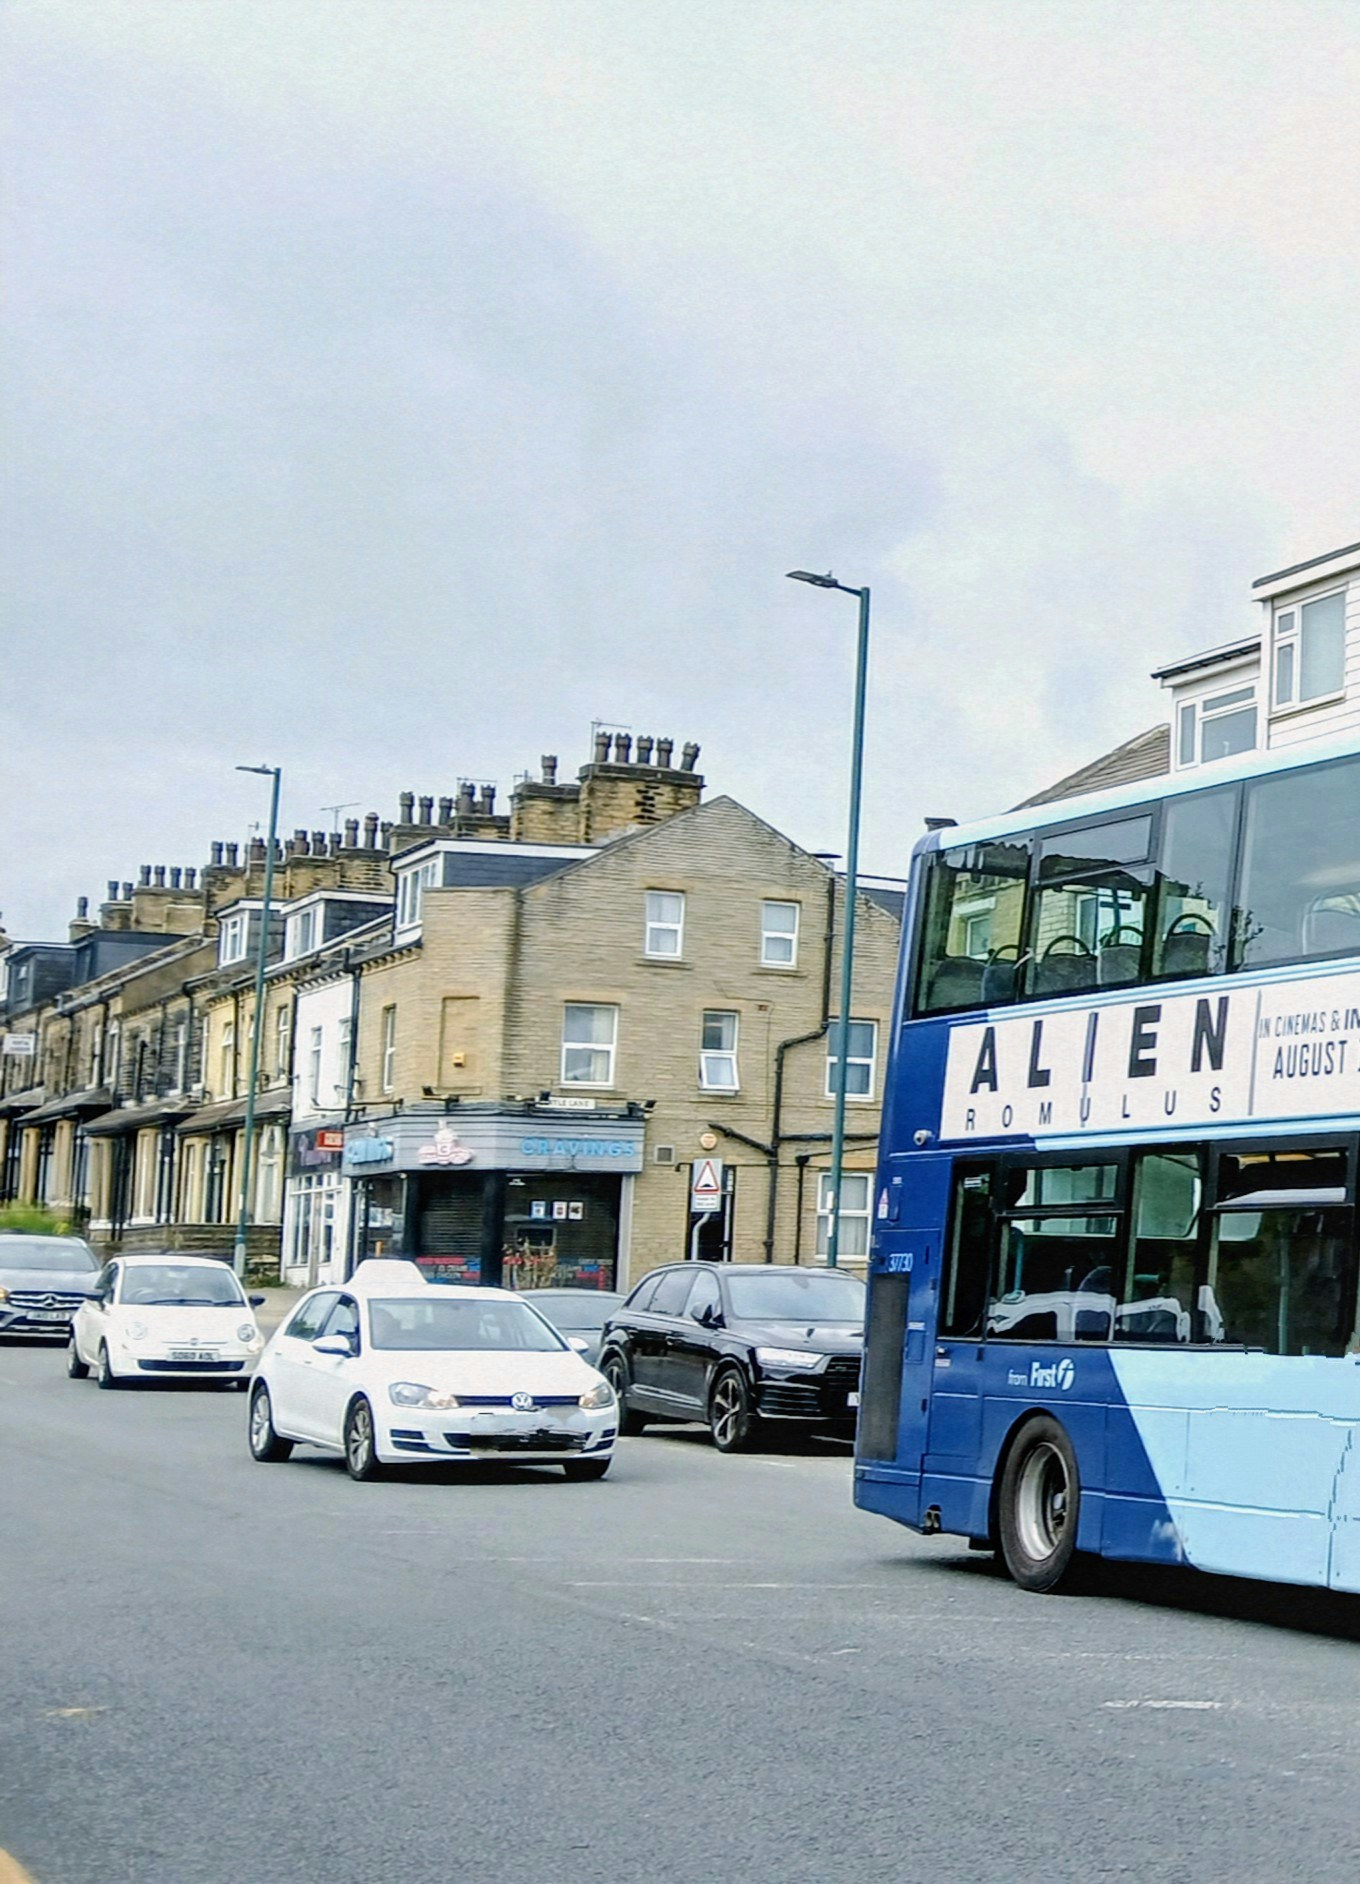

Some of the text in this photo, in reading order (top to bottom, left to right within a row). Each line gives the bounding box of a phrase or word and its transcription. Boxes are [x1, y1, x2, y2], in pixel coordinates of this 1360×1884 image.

[1258, 1017, 1271, 1039] IN
[1275, 1011, 1327, 1037] CINEMAS
[1331, 1010, 1341, 1032] &
[970, 996, 1230, 1094] ALIEN
[1272, 1040, 1348, 1080] AUGUST
[965, 1086, 1222, 1131] ROMULUS
[520, 1137, 635, 1158] CRAVINGS
[888, 1253, 913, 1272] 37730
[1007, 1369, 1028, 1386] from
[1030, 1362, 1056, 1388] First
